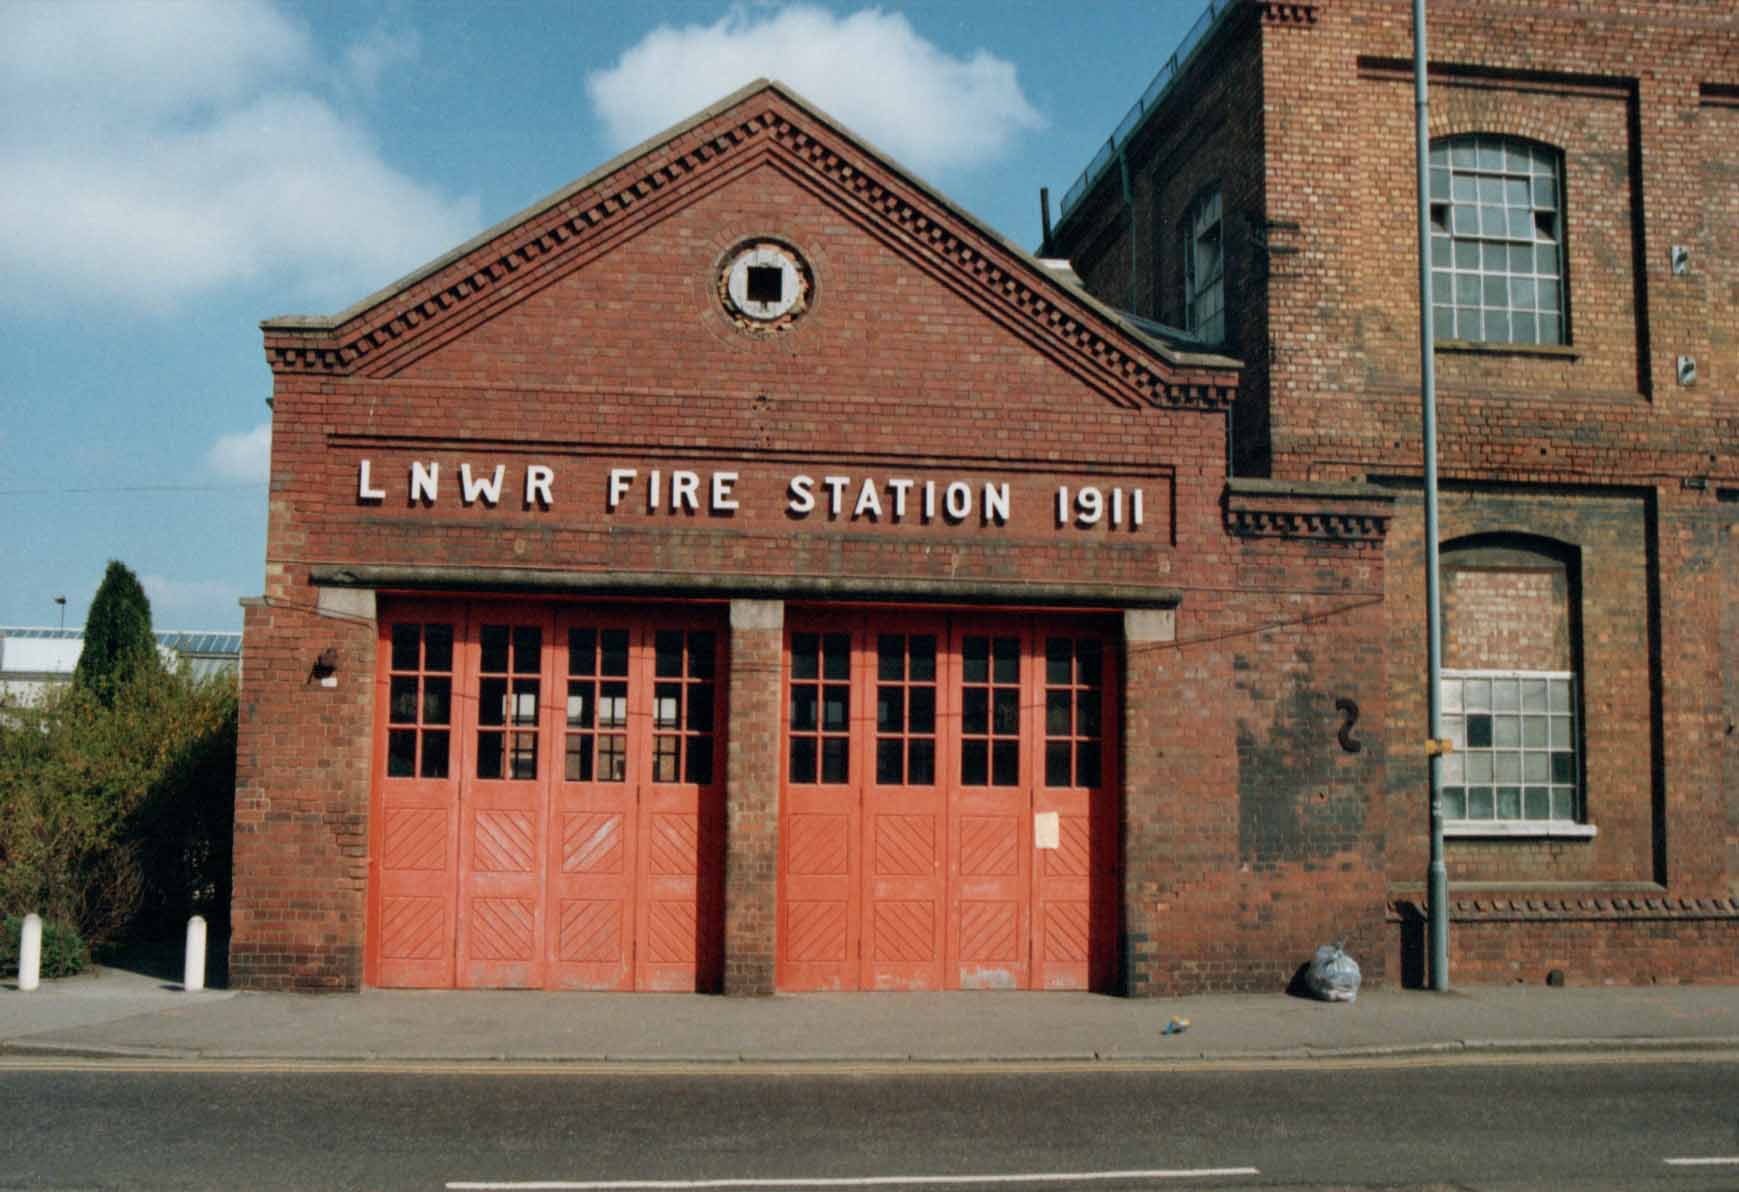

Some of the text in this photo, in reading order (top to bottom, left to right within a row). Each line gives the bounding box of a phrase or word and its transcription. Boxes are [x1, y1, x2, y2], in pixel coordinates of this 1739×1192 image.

[609, 468, 740, 511] FIRE
[788, 475, 1011, 521] STATION
[1058, 485, 1144, 525] 1911
